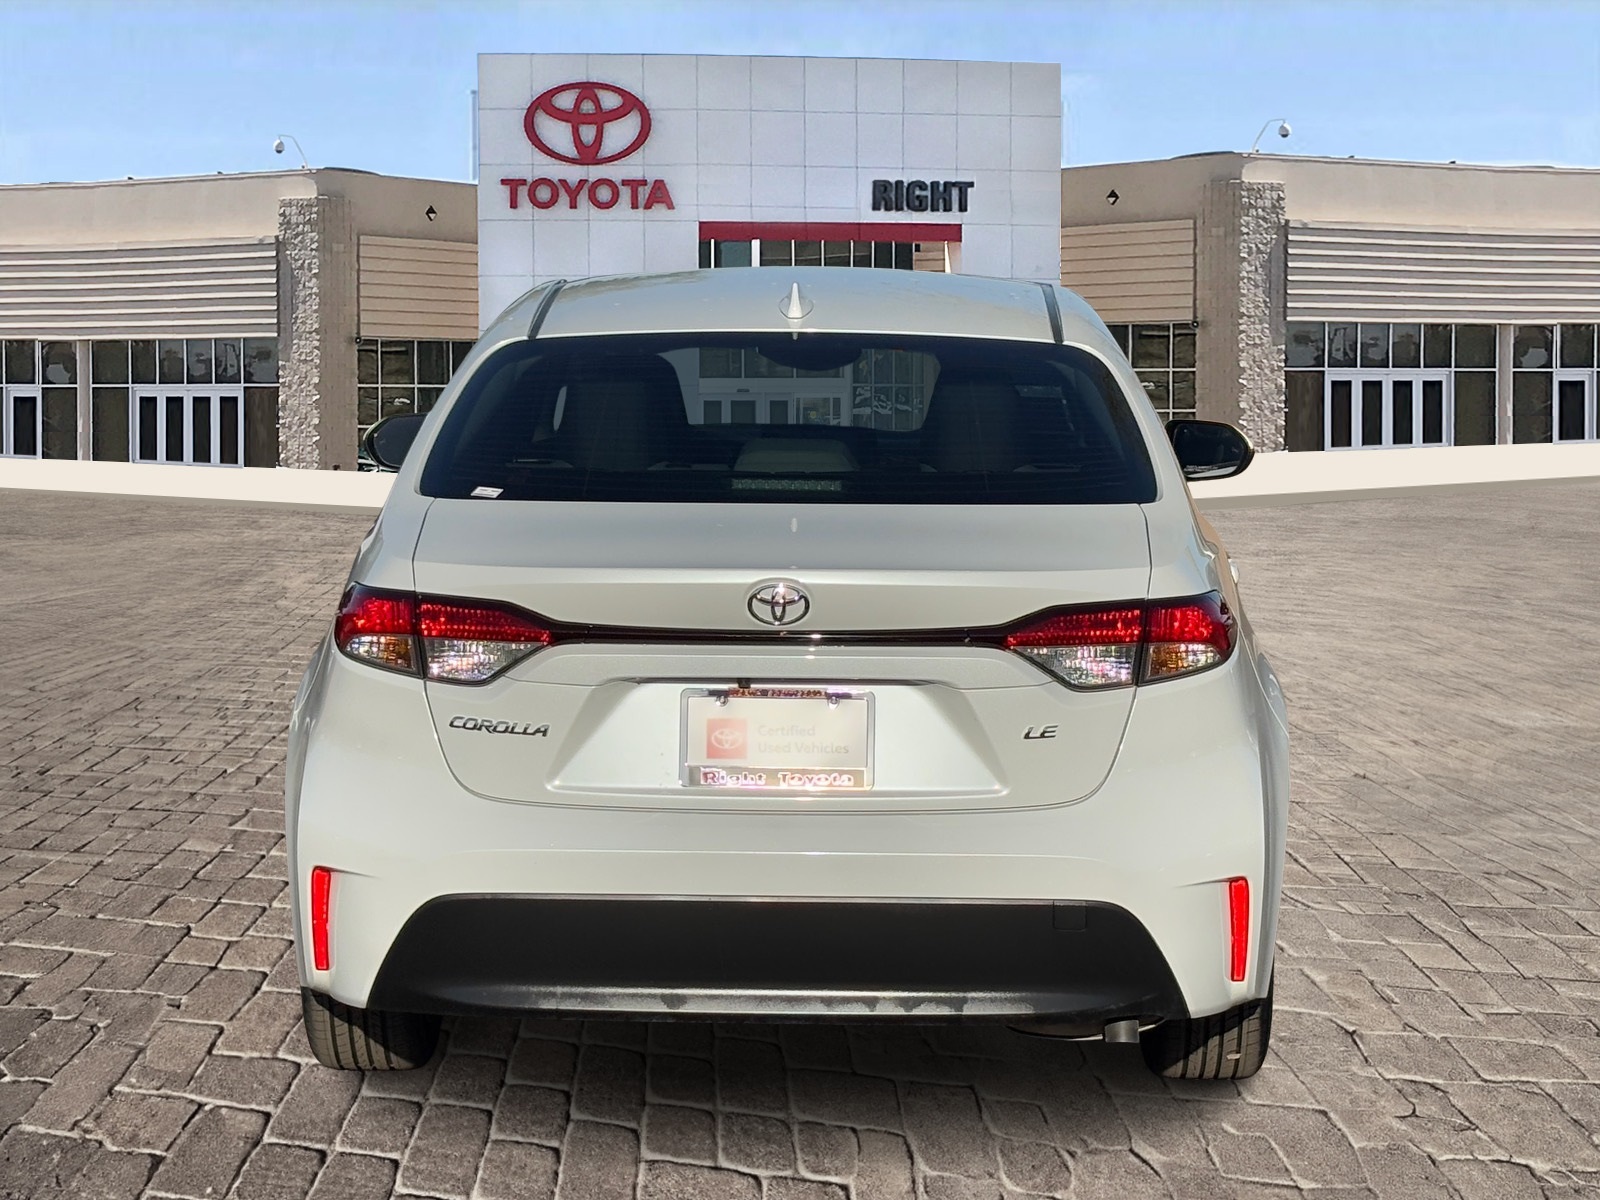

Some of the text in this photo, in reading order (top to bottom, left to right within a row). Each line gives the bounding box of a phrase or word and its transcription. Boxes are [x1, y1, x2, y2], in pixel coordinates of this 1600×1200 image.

[500, 177, 675, 210] TOYOTA
[871, 179, 975, 212] RIGHT
[448, 715, 550, 737] COROLLA
[757, 725, 816, 737] Certified
[1023, 724, 1059, 740] LE
[758, 742, 849, 754] Used Vehicles
[700, 768, 854, 786] Right Toyota
